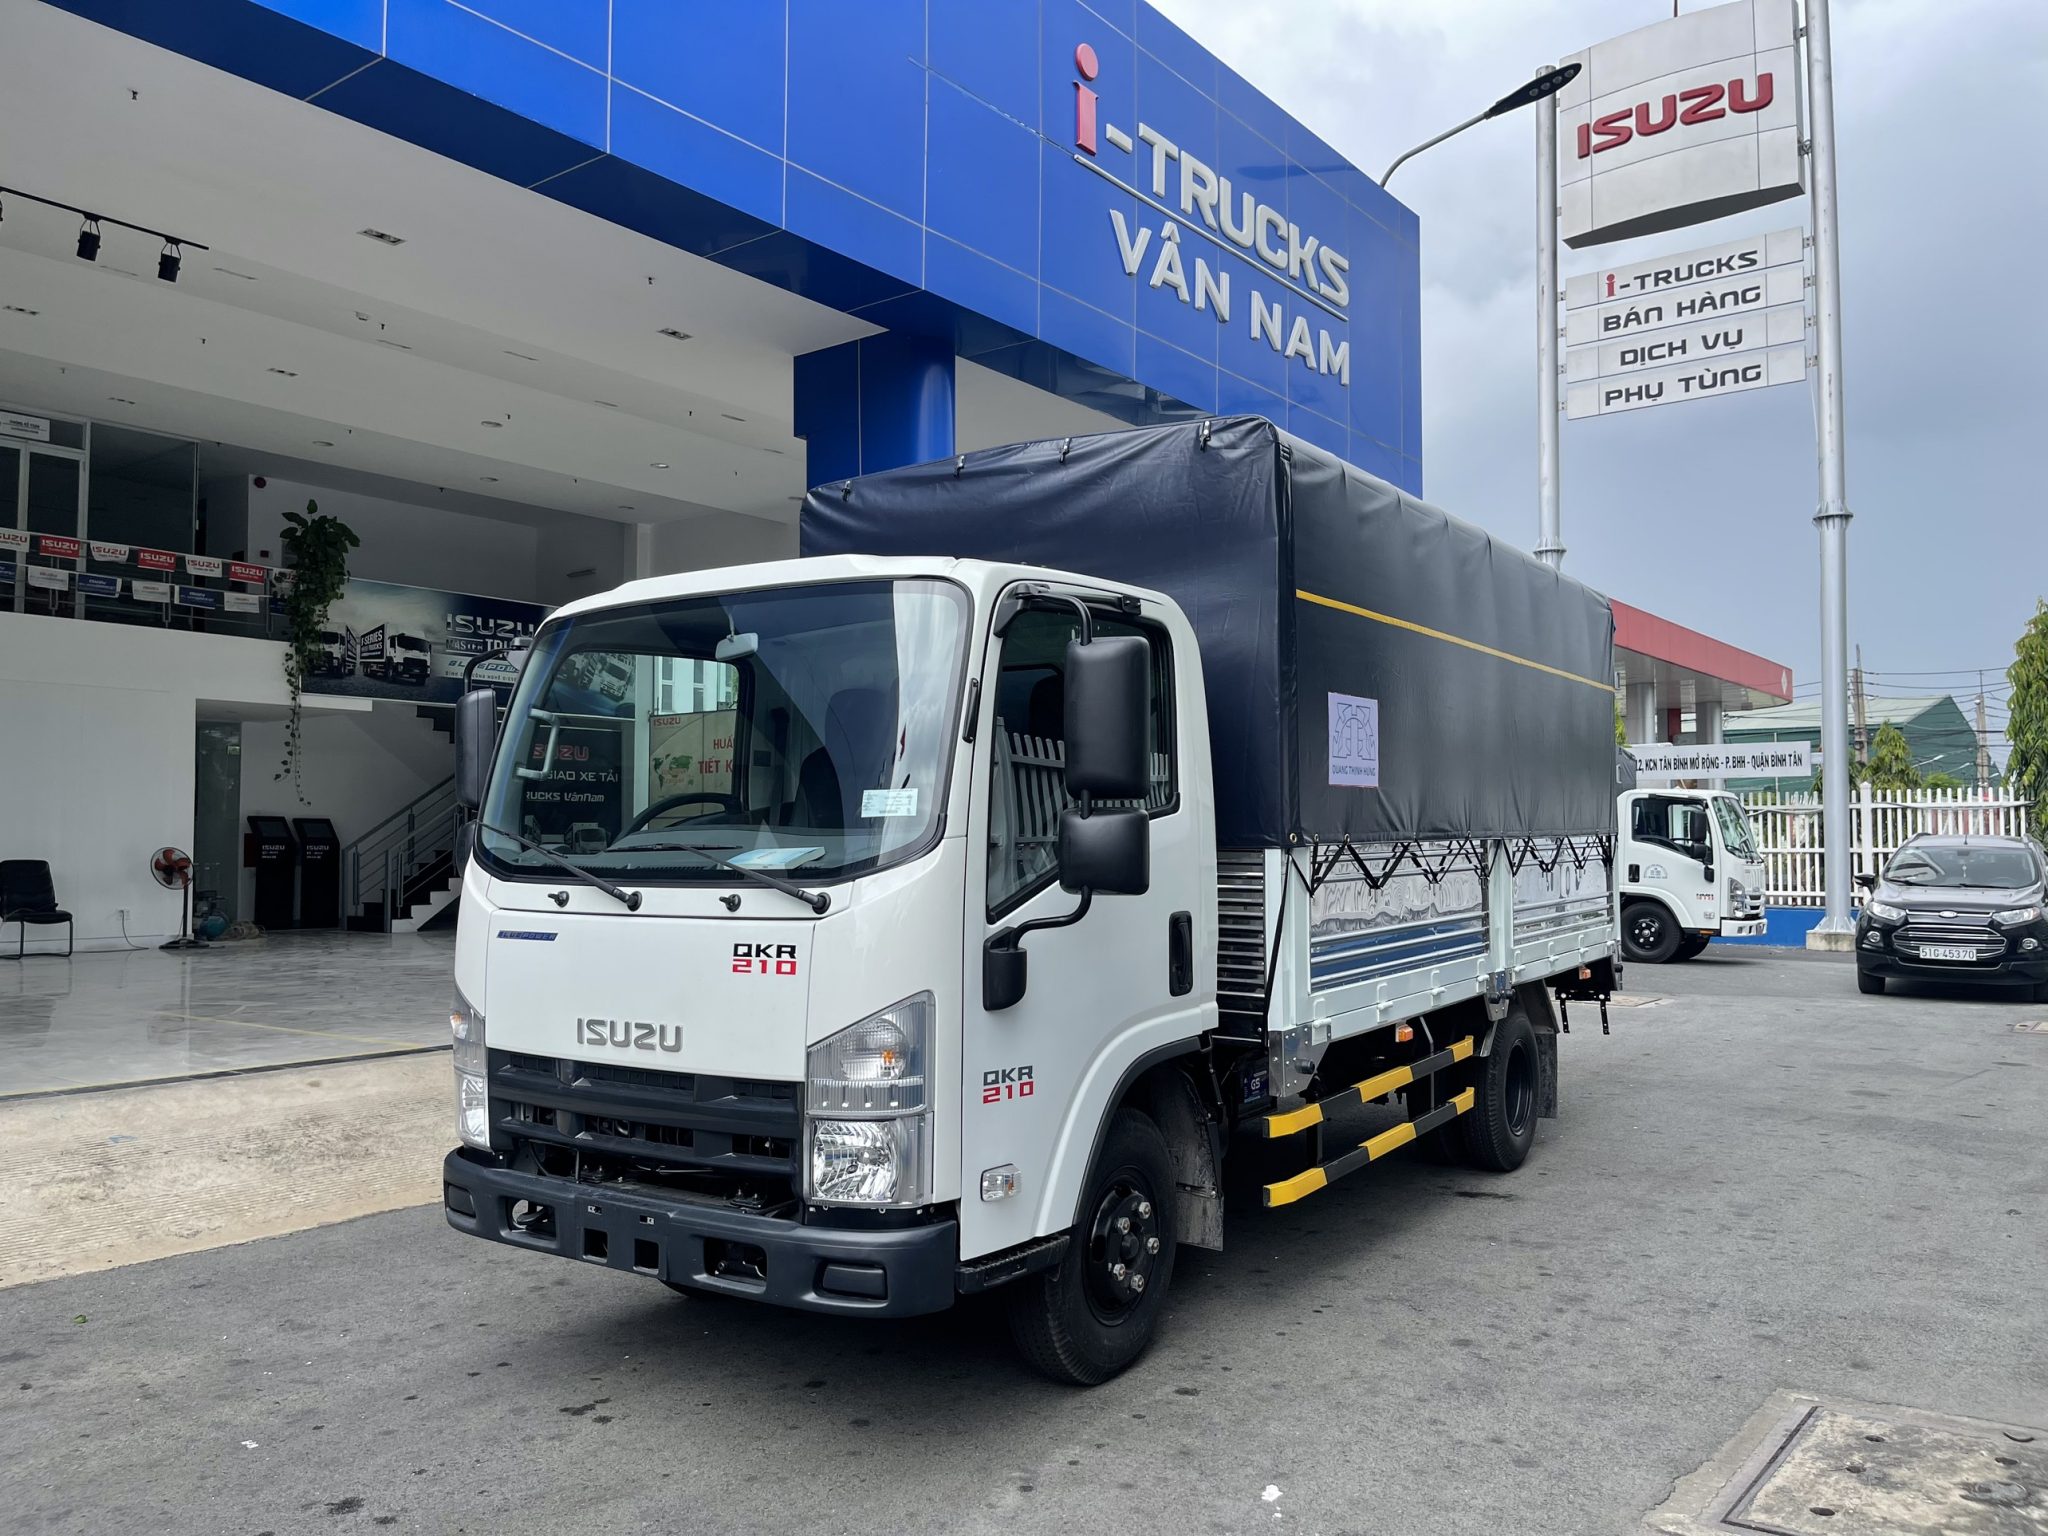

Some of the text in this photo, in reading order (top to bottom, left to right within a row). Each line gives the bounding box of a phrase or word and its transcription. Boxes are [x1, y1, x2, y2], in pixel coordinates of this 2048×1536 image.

[1577, 72, 1773, 159] ISUZU
[1073, 43, 1349, 307] i-TRUCKS
[1605, 250, 1758, 298] i-TRUCKS
[1109, 208, 1350, 386] VÂN NAM
[1603, 285, 1761, 332] BÁN HÀNG
[1619, 328, 1743, 366] DỊCH VỤ
[1604, 364, 1762, 407] PHỤ TÙNG
[42, 539, 79, 550] ISUZU
[92, 546, 127, 556] ISUZU
[140, 552, 175, 563] ISUZU
[187, 559, 220, 569] ISUZU
[231, 565, 263, 577] ISUZU
[446, 613, 534, 638] ISUZU
[653, 717, 681, 726] ISUZU
[1645, 758, 1658, 771] KCN
[1659, 755, 1672, 770] TÂN
[1673, 755, 1689, 770] BÌNH
[1689, 752, 1700, 770] MỞ
[1701, 755, 1720, 773] RỘNG
[1751, 753, 1770, 772] QUẬN
[1770, 751, 1786, 767] BÌNH
[1788, 750, 1803, 767] TÂN
[579, 772, 597, 782] XE
[599, 769, 618, 783] TẢI
[732, 943, 797, 959] QKR
[732, 958, 797, 975] 210
[576, 1017, 683, 1053] ISUZU
[983, 1065, 1034, 1086] QKR
[1250, 1077, 1261, 1090] GS
[983, 1081, 1034, 1104] 210
